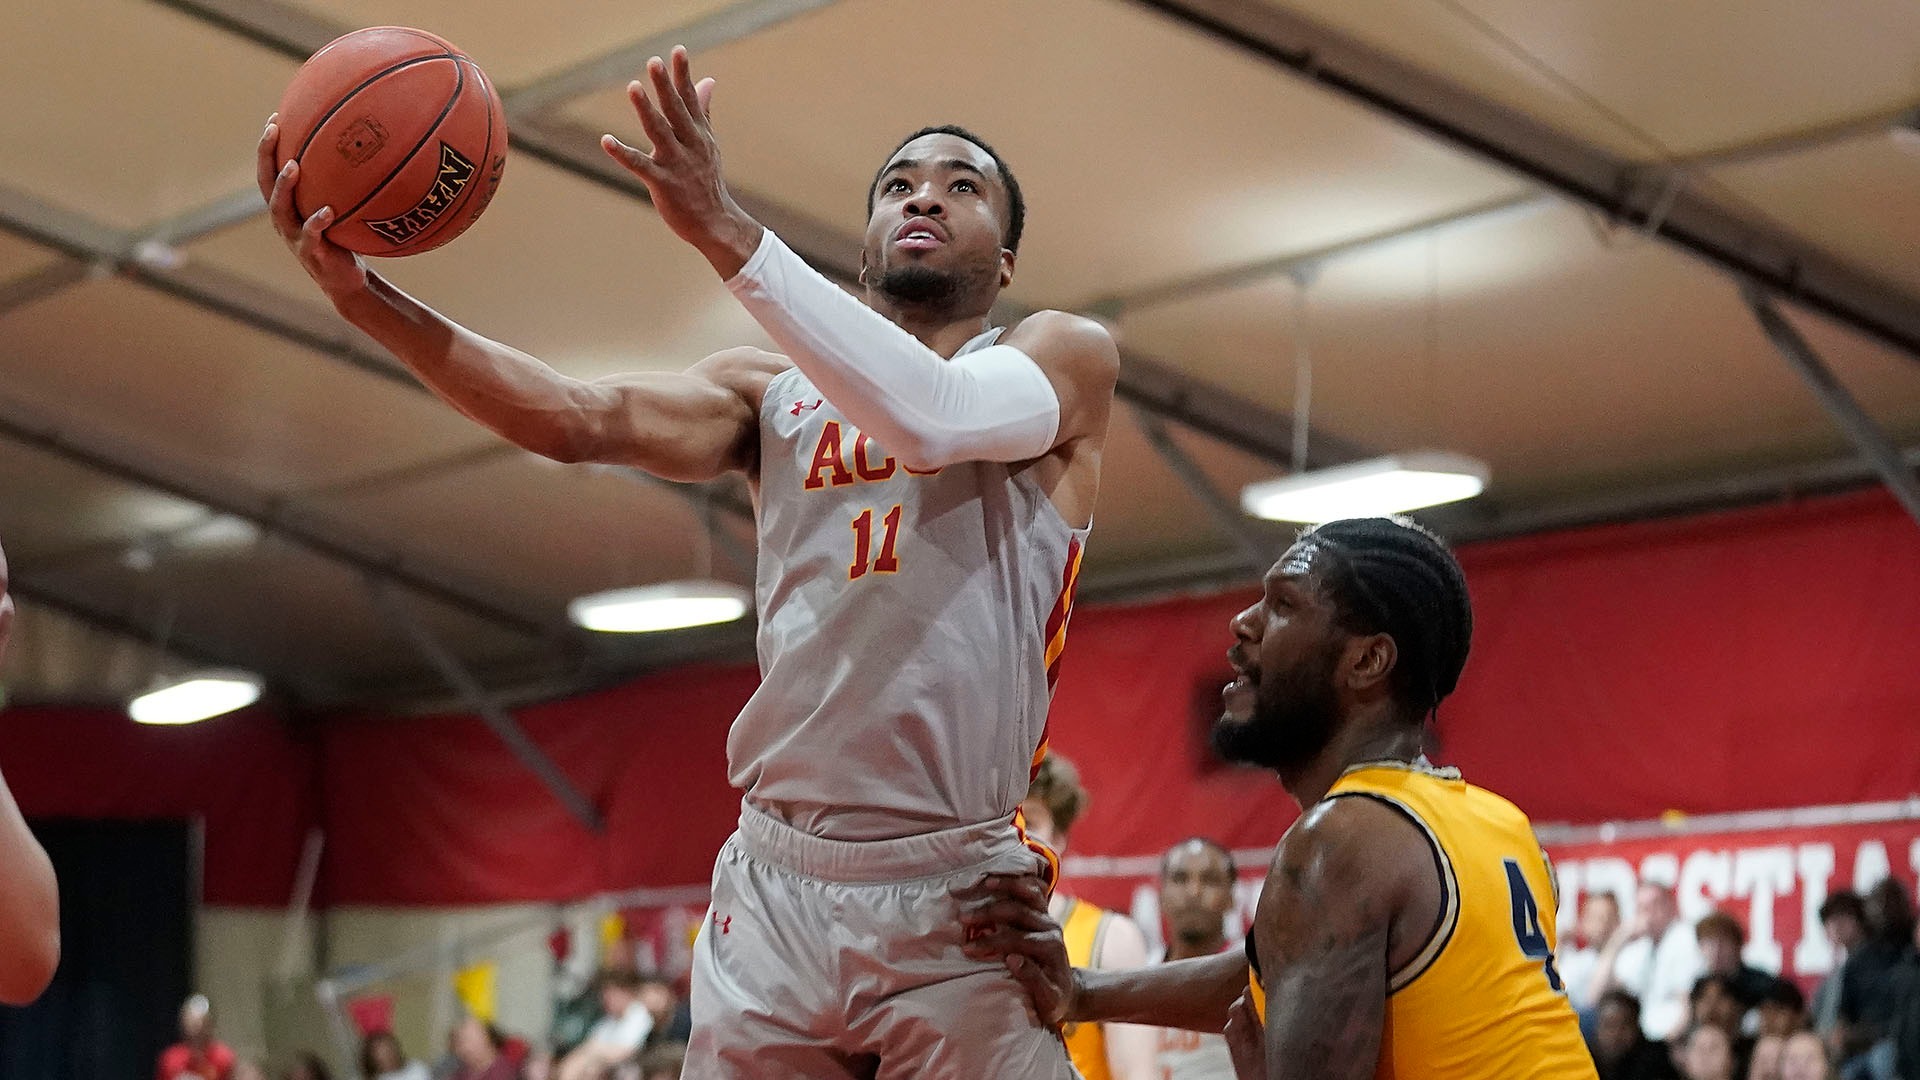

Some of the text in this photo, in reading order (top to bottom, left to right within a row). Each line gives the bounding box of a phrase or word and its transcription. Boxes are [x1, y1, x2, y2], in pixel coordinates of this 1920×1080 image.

[363, 141, 476, 244] NAIA
[803, 420, 945, 490] AC
[848, 503, 902, 581] 11
[1501, 858, 1564, 995] 4
